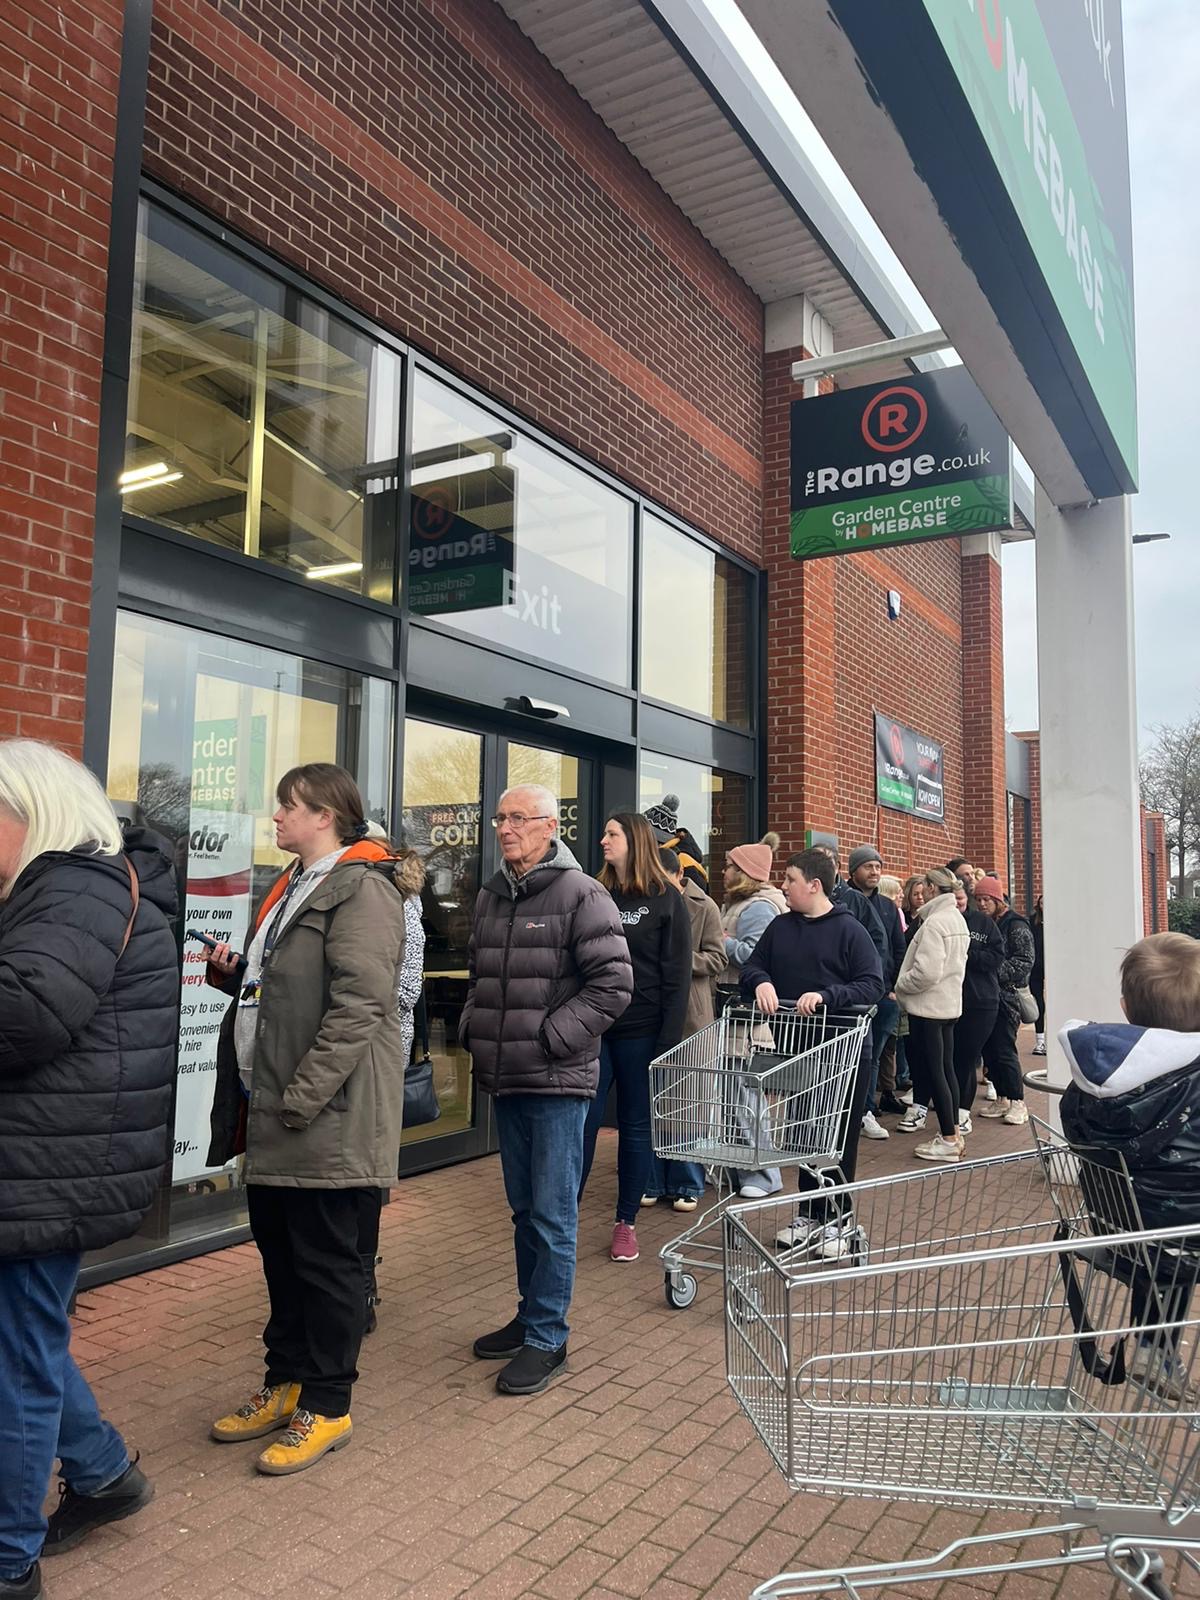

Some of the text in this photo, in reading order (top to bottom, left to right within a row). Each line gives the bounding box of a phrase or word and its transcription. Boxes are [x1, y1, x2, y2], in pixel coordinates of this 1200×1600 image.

[805, 471, 815, 496] The
[817, 454, 936, 494] Range
[832, 495, 961, 527] Garden Centre
[835, 511, 947, 541] by HOMEBASE
[503, 568, 562, 635] Exit
[432, 812, 455, 823] FREE
[186, 909, 232, 922] your own
[199, 1002, 208, 1014] to
[210, 1002, 225, 1013] use
[184, 1039, 202, 1052] hire
[177, 1061, 196, 1075] reat
